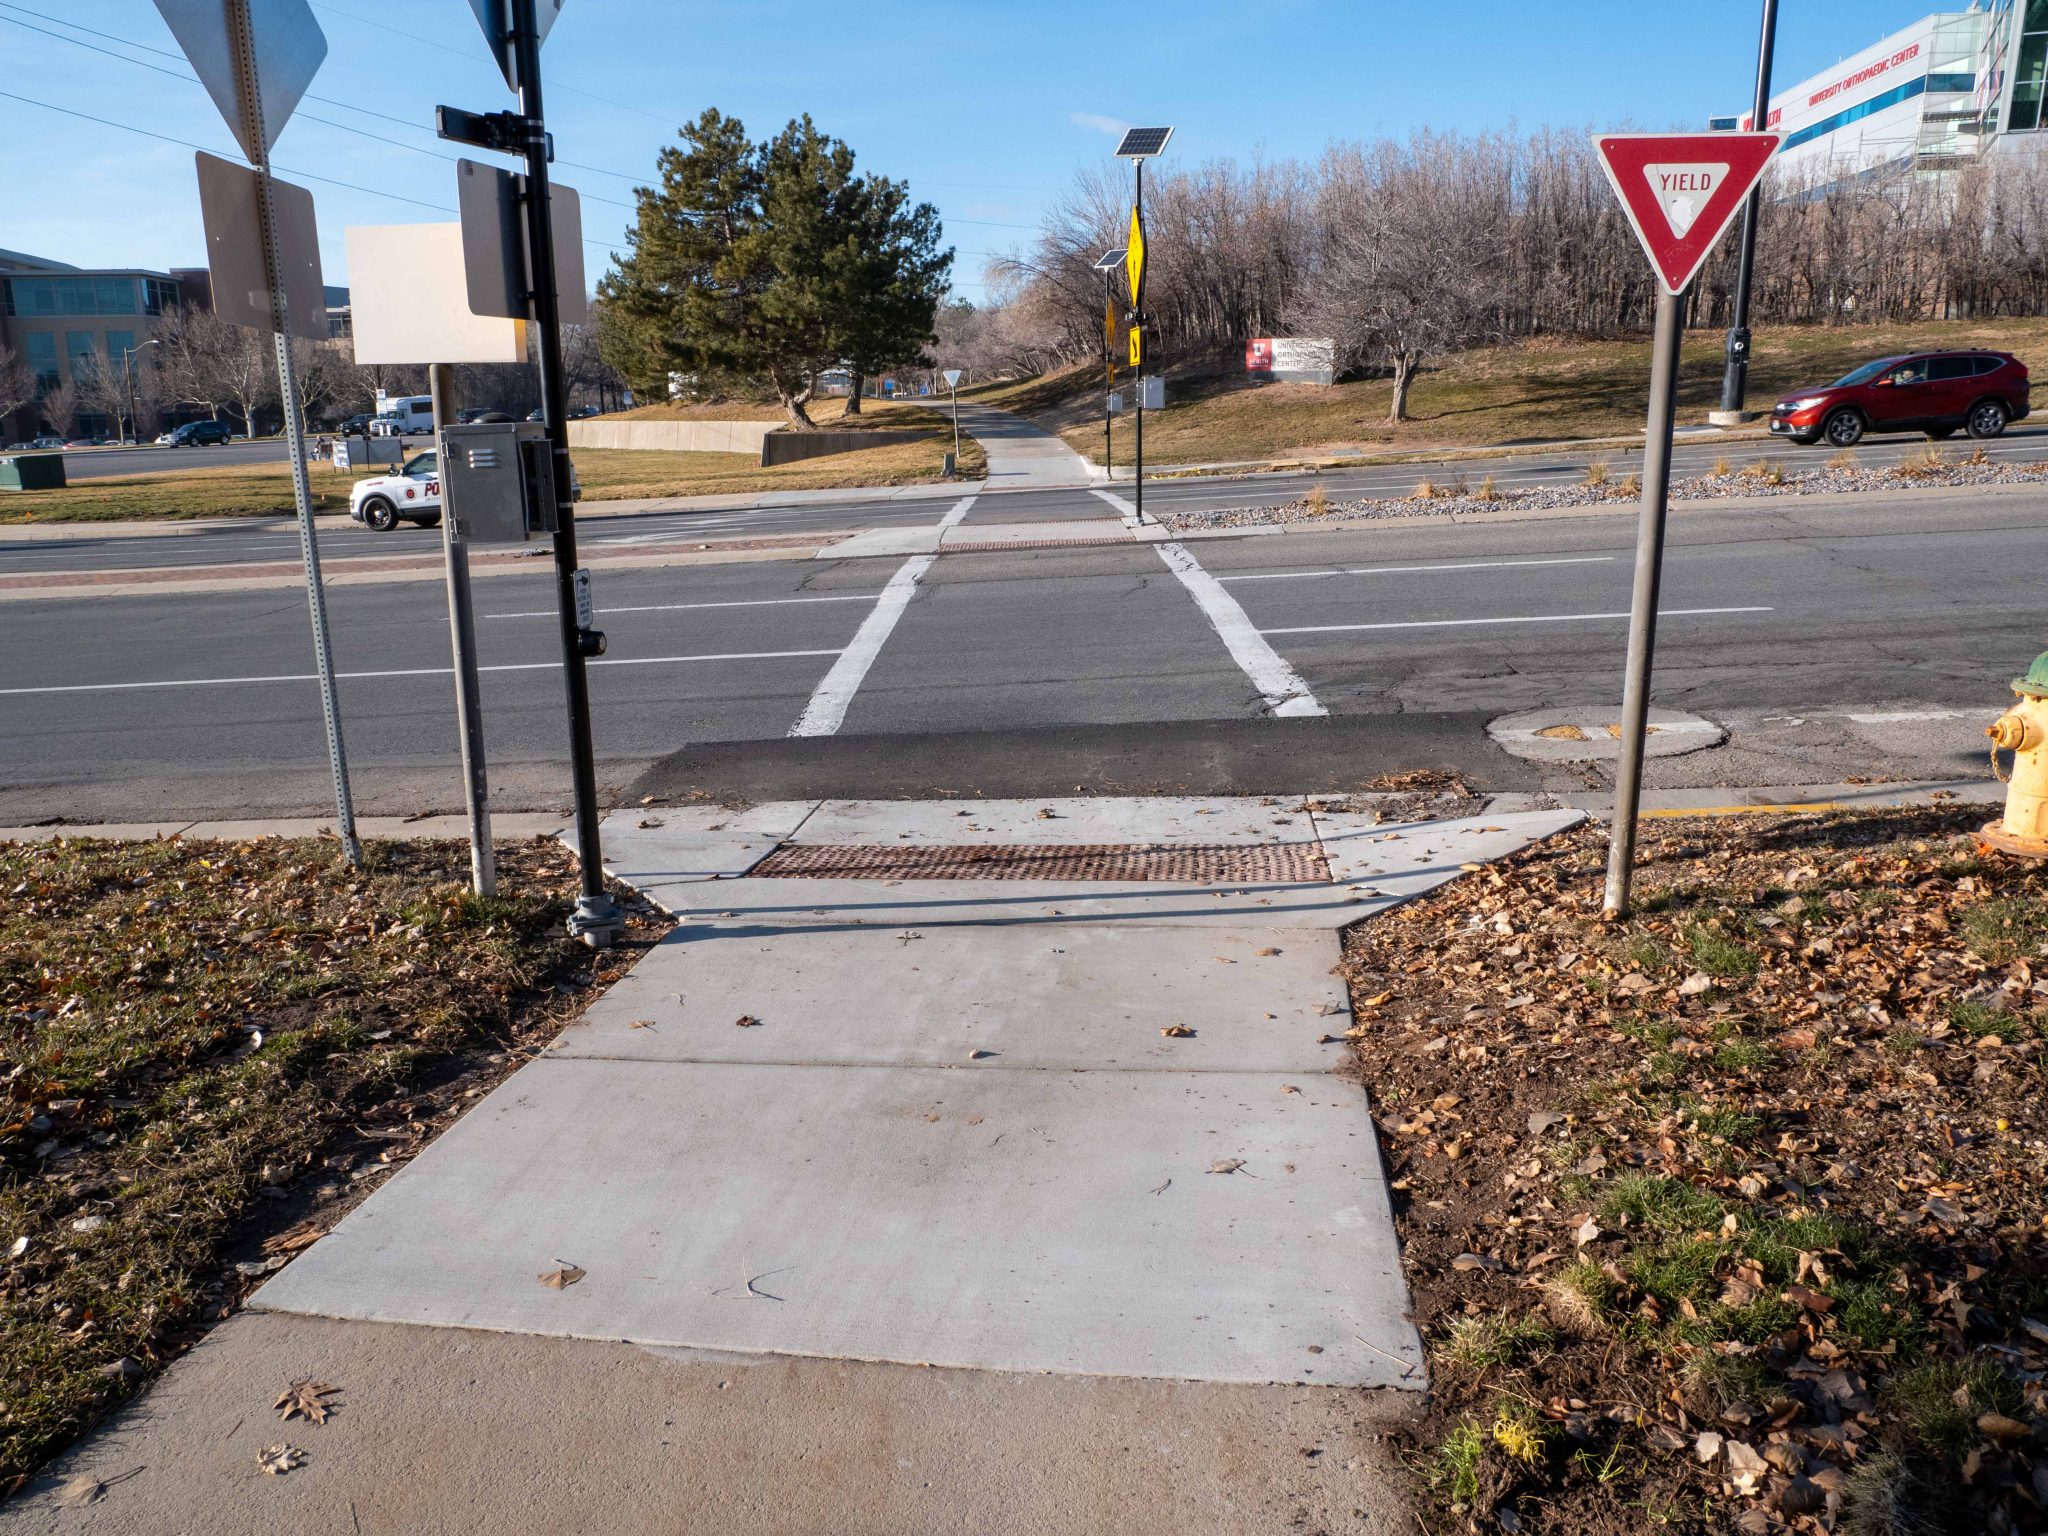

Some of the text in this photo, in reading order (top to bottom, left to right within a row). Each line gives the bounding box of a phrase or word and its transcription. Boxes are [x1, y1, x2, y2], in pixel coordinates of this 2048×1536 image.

[1808, 44, 1920, 107] UNIVERSITY ORTHOPAEDIC CENTER
[1660, 173, 1711, 191] YIELD
